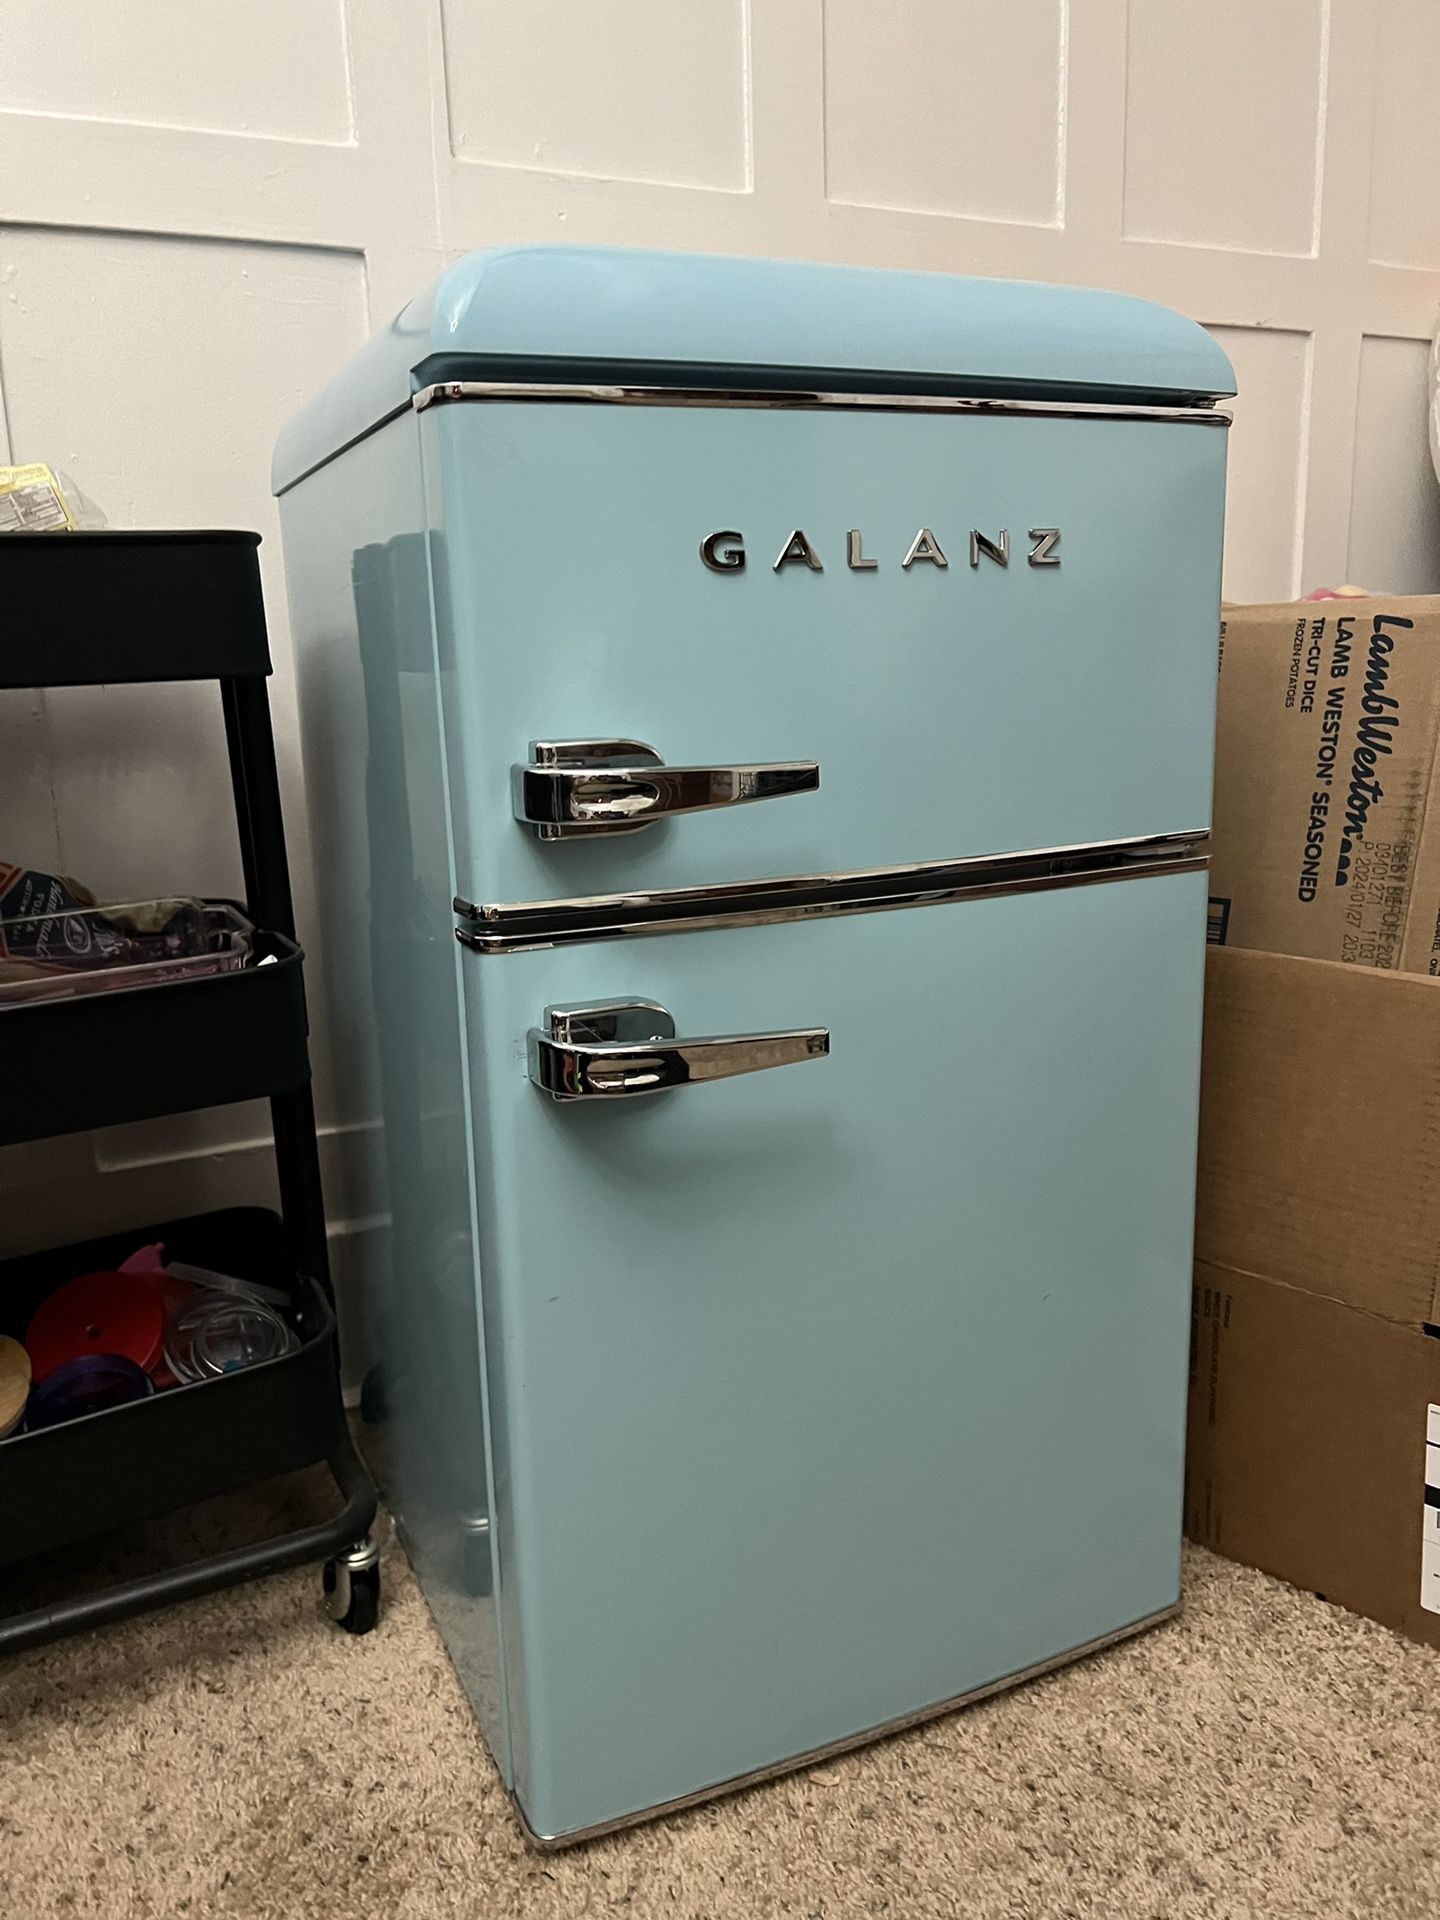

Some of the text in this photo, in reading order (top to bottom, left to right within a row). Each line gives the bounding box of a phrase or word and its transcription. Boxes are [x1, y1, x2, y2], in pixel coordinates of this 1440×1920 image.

[699, 527, 1062, 573] GALANZ
[1285, 618, 1305, 708] FROZEN POTATOES
[1300, 617, 1325, 714] TRI-CUT DICE
[1331, 617, 1355, 679] LAMB
[1298, 791, 1329, 903] SEASONED
[26, 892, 45, 933] VODA
[1345, 857, 1371, 928] 2024/01/27
[1379, 885, 1404, 943] BEFORE
